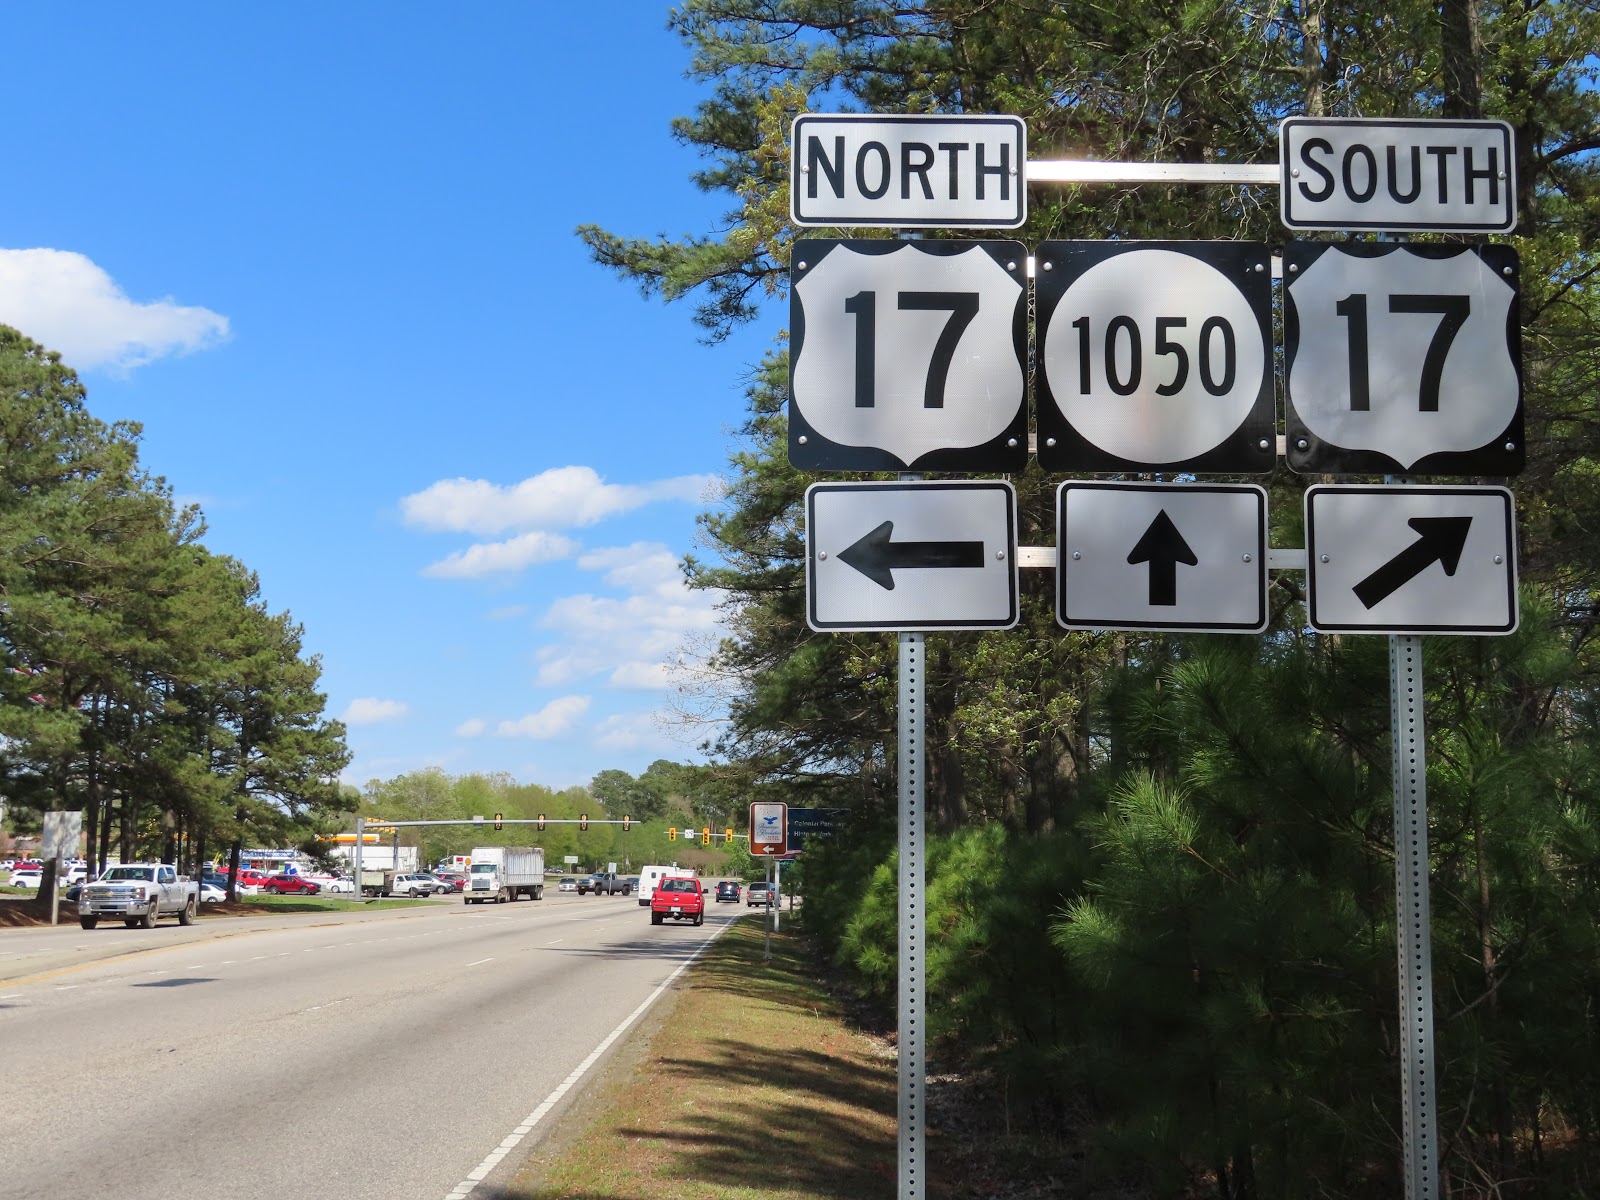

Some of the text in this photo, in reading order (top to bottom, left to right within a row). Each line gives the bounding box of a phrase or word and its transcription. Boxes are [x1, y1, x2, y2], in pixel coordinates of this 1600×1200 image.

[806, 136, 1010, 200] NORTH
[1298, 138, 1499, 205] SOUTH
[845, 291, 980, 408] 17
[1073, 316, 1237, 396] 1050
[1337, 293, 1471, 412] 17
